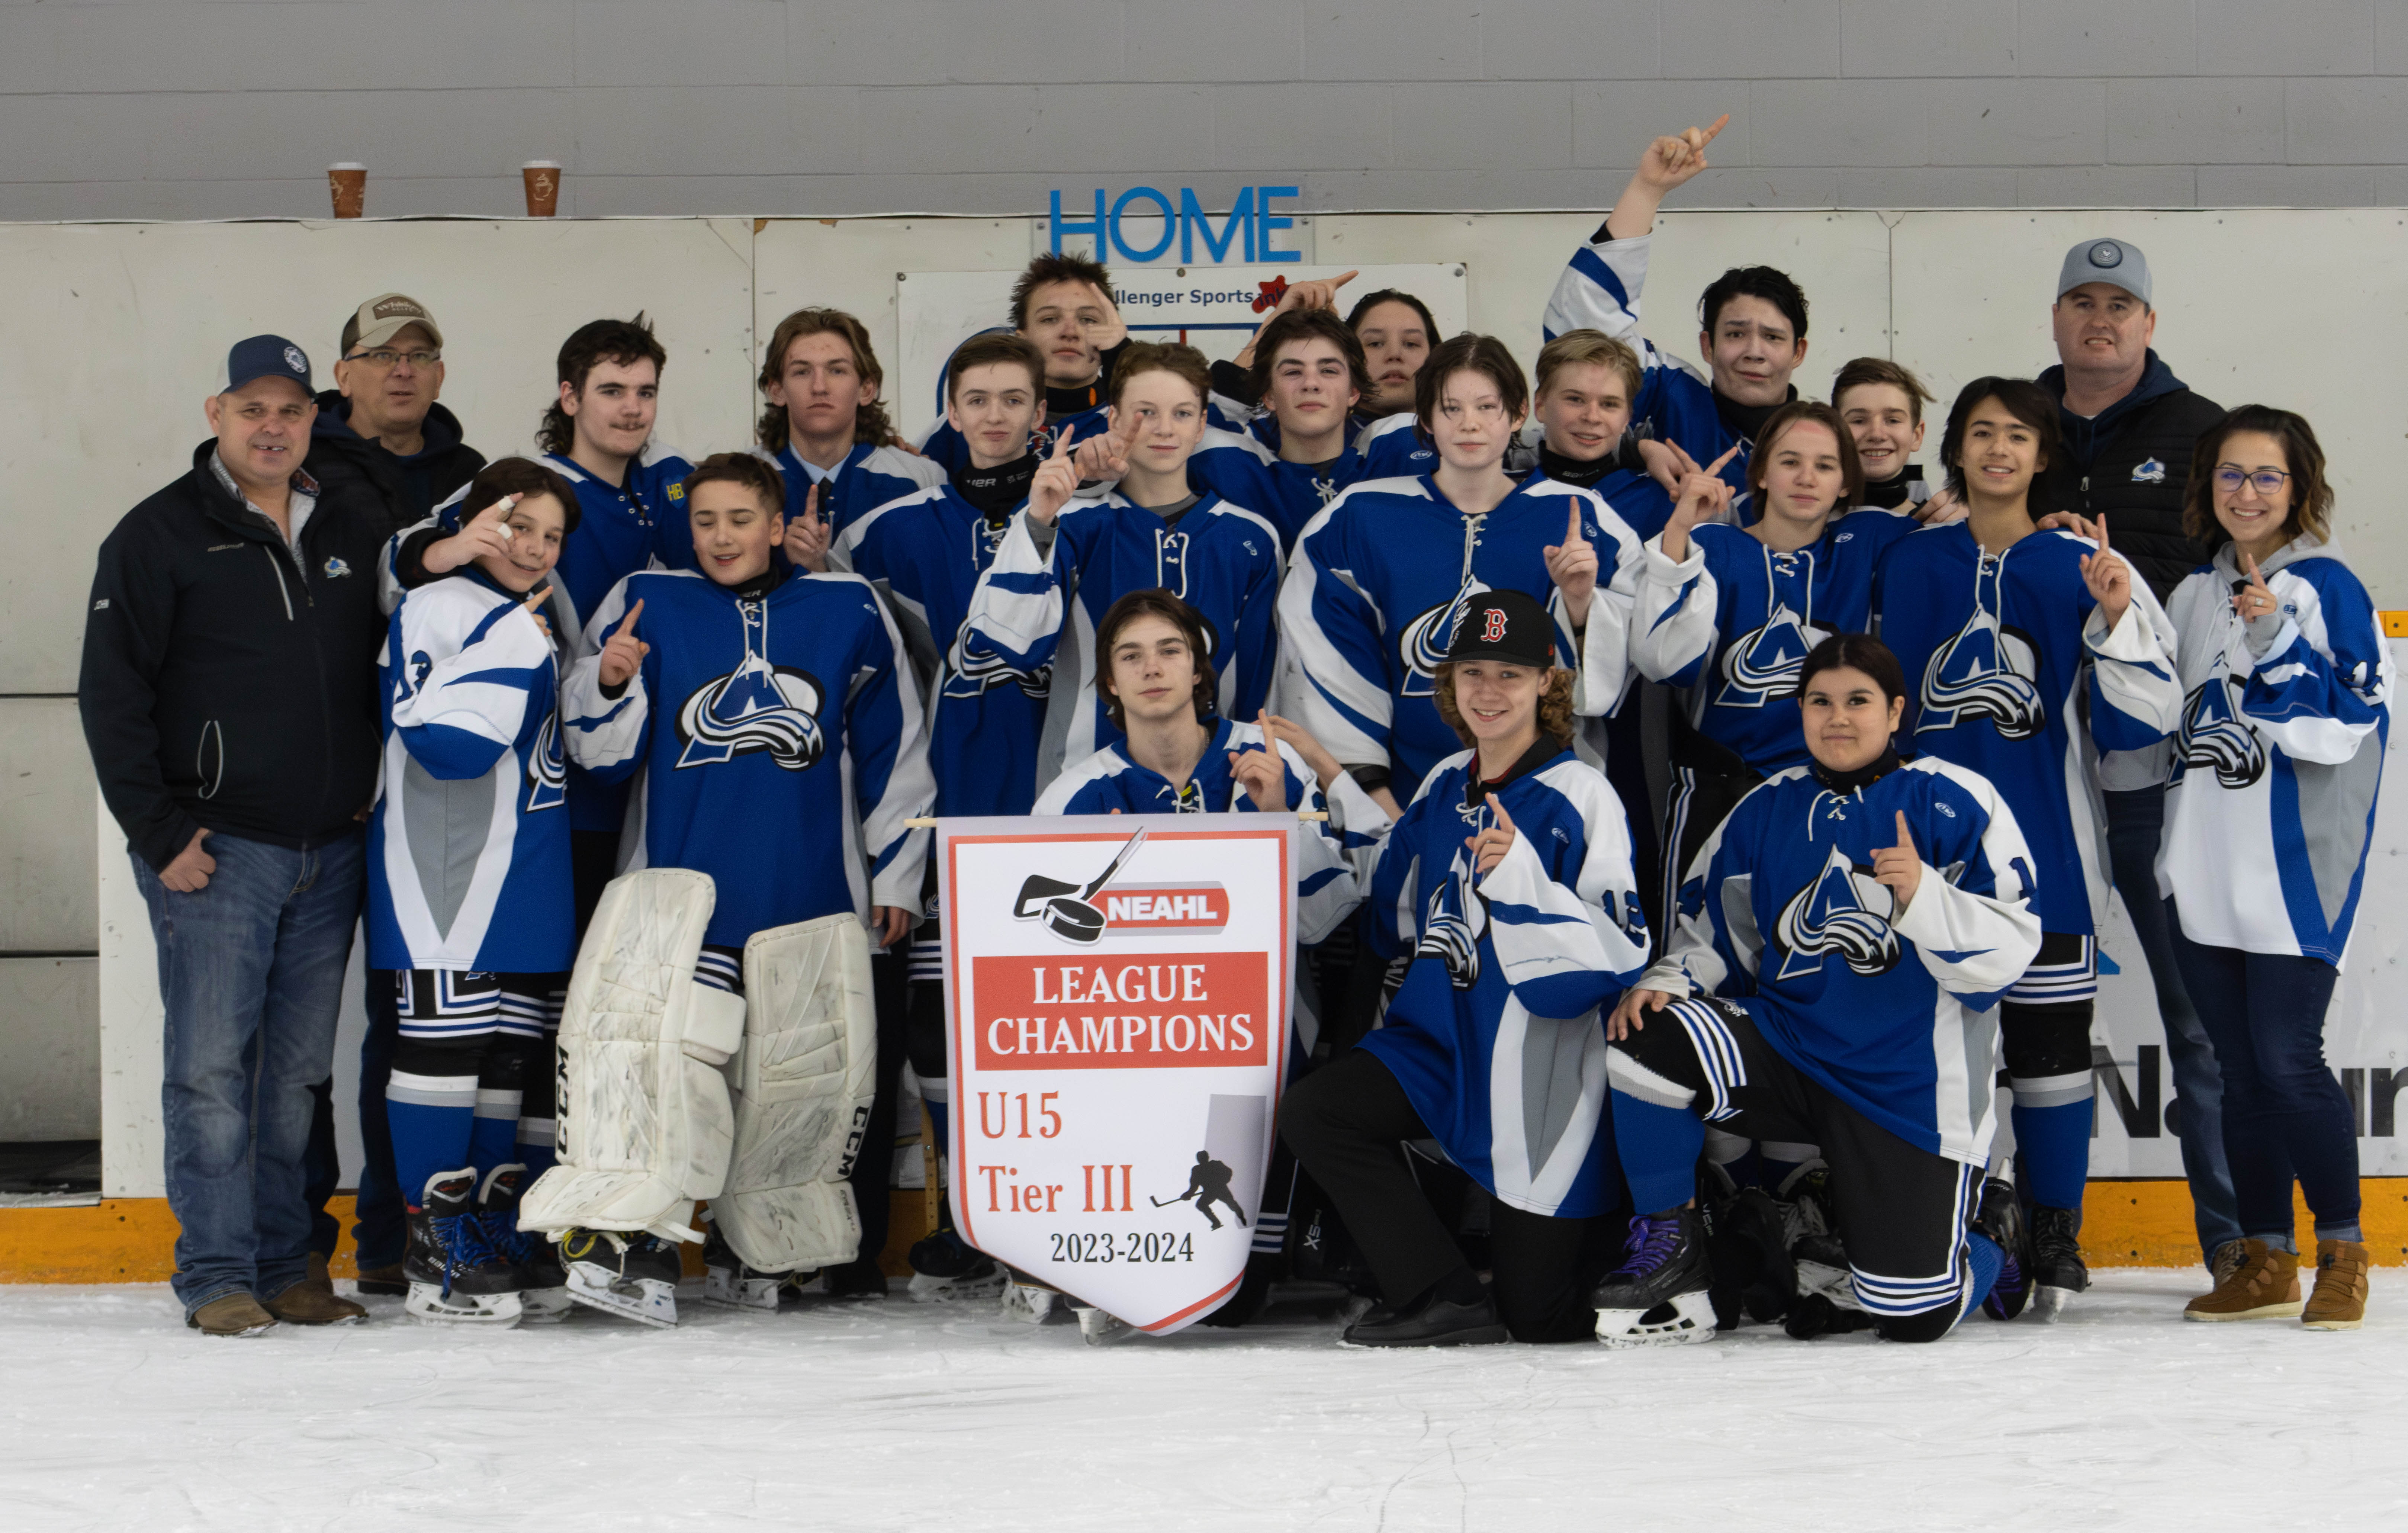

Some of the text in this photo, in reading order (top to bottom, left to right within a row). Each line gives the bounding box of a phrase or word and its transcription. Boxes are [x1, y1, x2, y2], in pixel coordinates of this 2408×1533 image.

[1050, 186, 1301, 264] HOME
[1115, 290, 1184, 306] llenger
[1190, 289, 1254, 306] Sports
[667, 483, 684, 501] HB
[1481, 609, 1508, 642] B
[1107, 895, 1217, 921] NEAHL
[1032, 964, 1208, 1004] LEAGUE
[987, 1014, 1254, 1055] CHAMPIONS
[558, 1045, 569, 1155] CCM
[978, 1090, 1062, 1139] U15
[838, 1106, 871, 1176] CCM
[978, 1165, 1134, 1212] Tier III
[1051, 1232, 1194, 1263] 2023-2024
